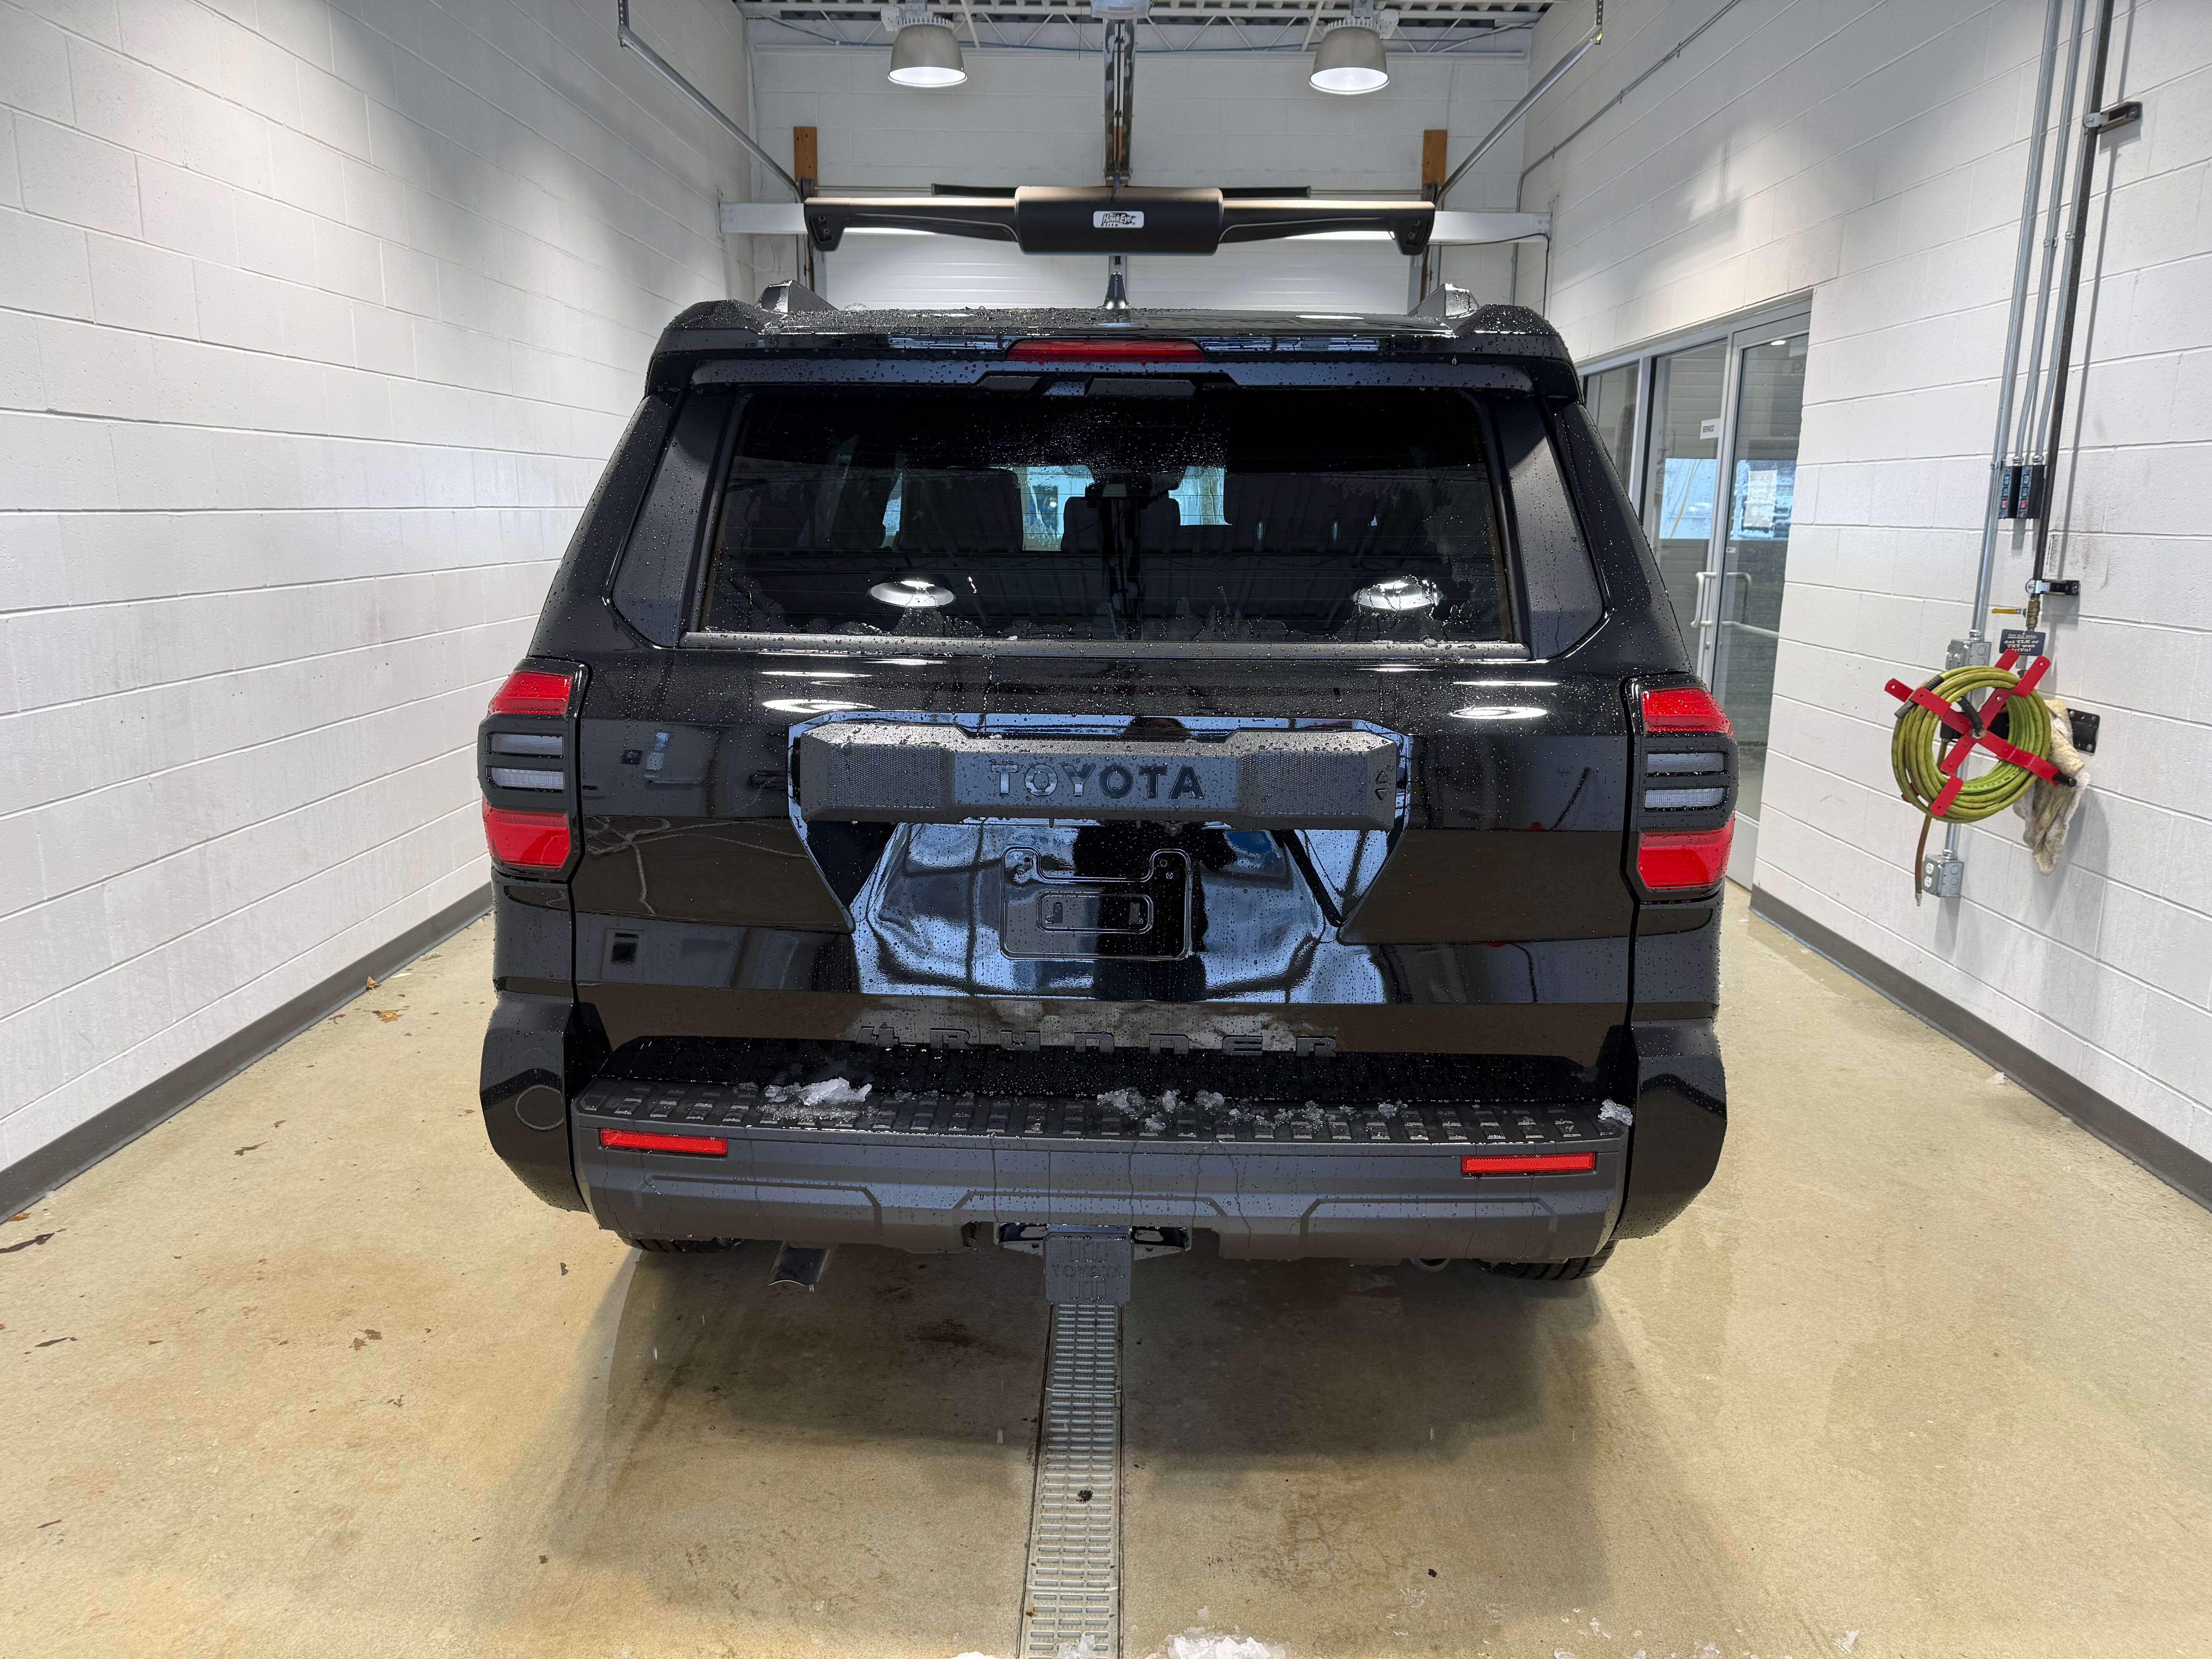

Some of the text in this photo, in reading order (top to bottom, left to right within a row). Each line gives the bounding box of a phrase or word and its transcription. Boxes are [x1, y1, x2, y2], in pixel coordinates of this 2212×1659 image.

[1102, 213, 1132, 224] HawkEye
[990, 763, 1205, 799] TOYOTA
[856, 1025, 1336, 1057] 4RUNNER
[1051, 1264, 1125, 1278] TOYOTA
